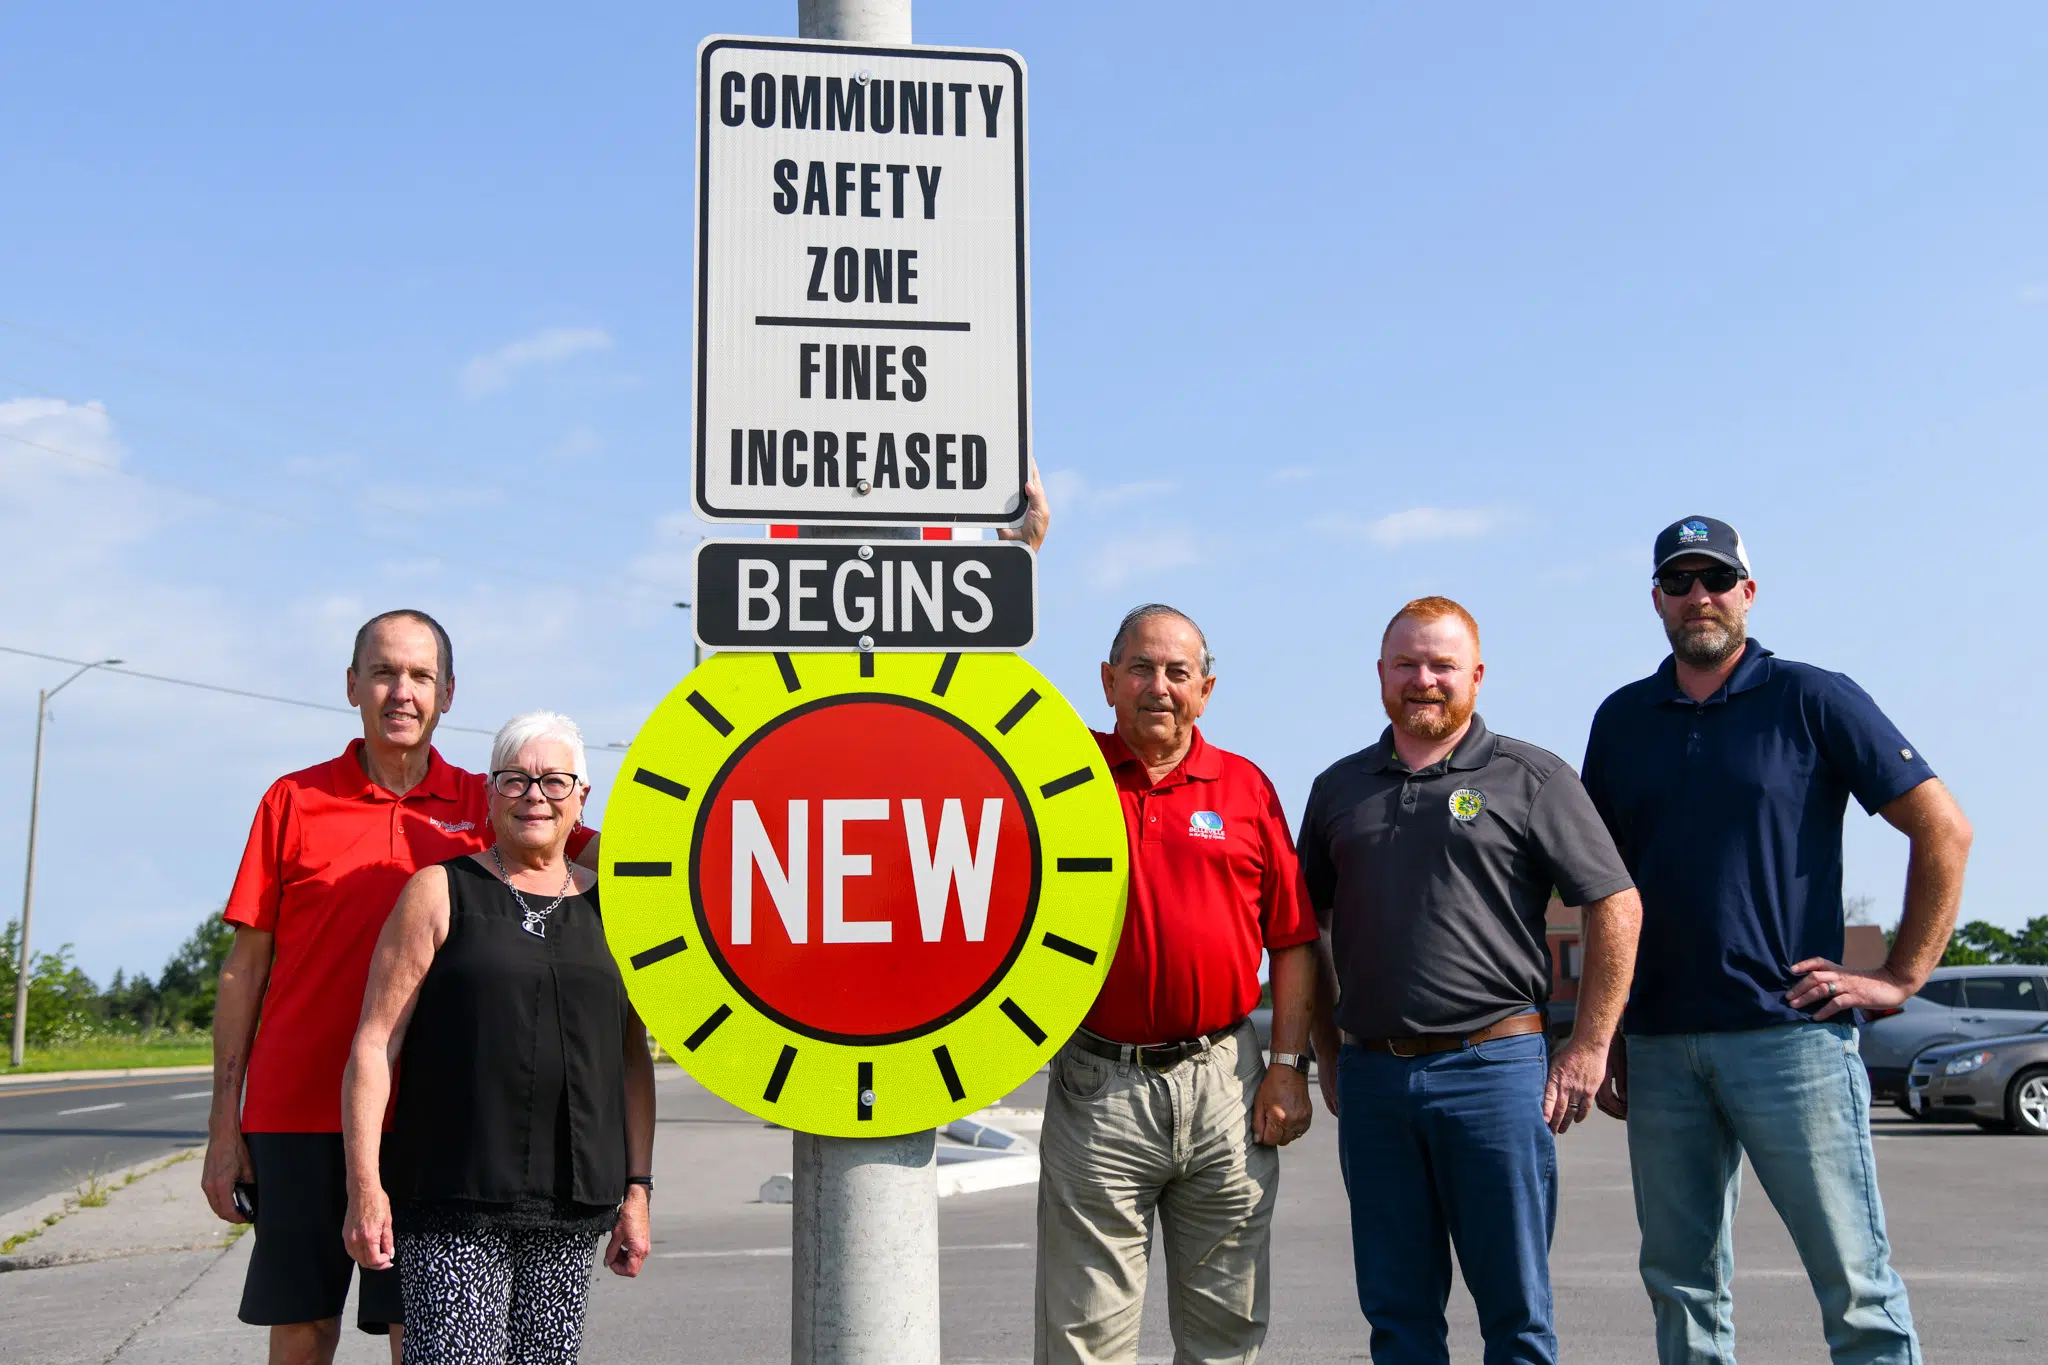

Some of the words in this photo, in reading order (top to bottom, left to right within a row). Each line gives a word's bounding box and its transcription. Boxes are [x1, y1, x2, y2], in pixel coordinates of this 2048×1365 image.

[719, 71, 1004, 138] COMMUNITY
[773, 159, 942, 220] SAFETY
[806, 246, 918, 304] ZONE
[799, 343, 927, 402] FINES
[730, 428, 987, 491] INCREASED
[738, 558, 994, 633] BEGINS
[731, 798, 1004, 945] NEW
